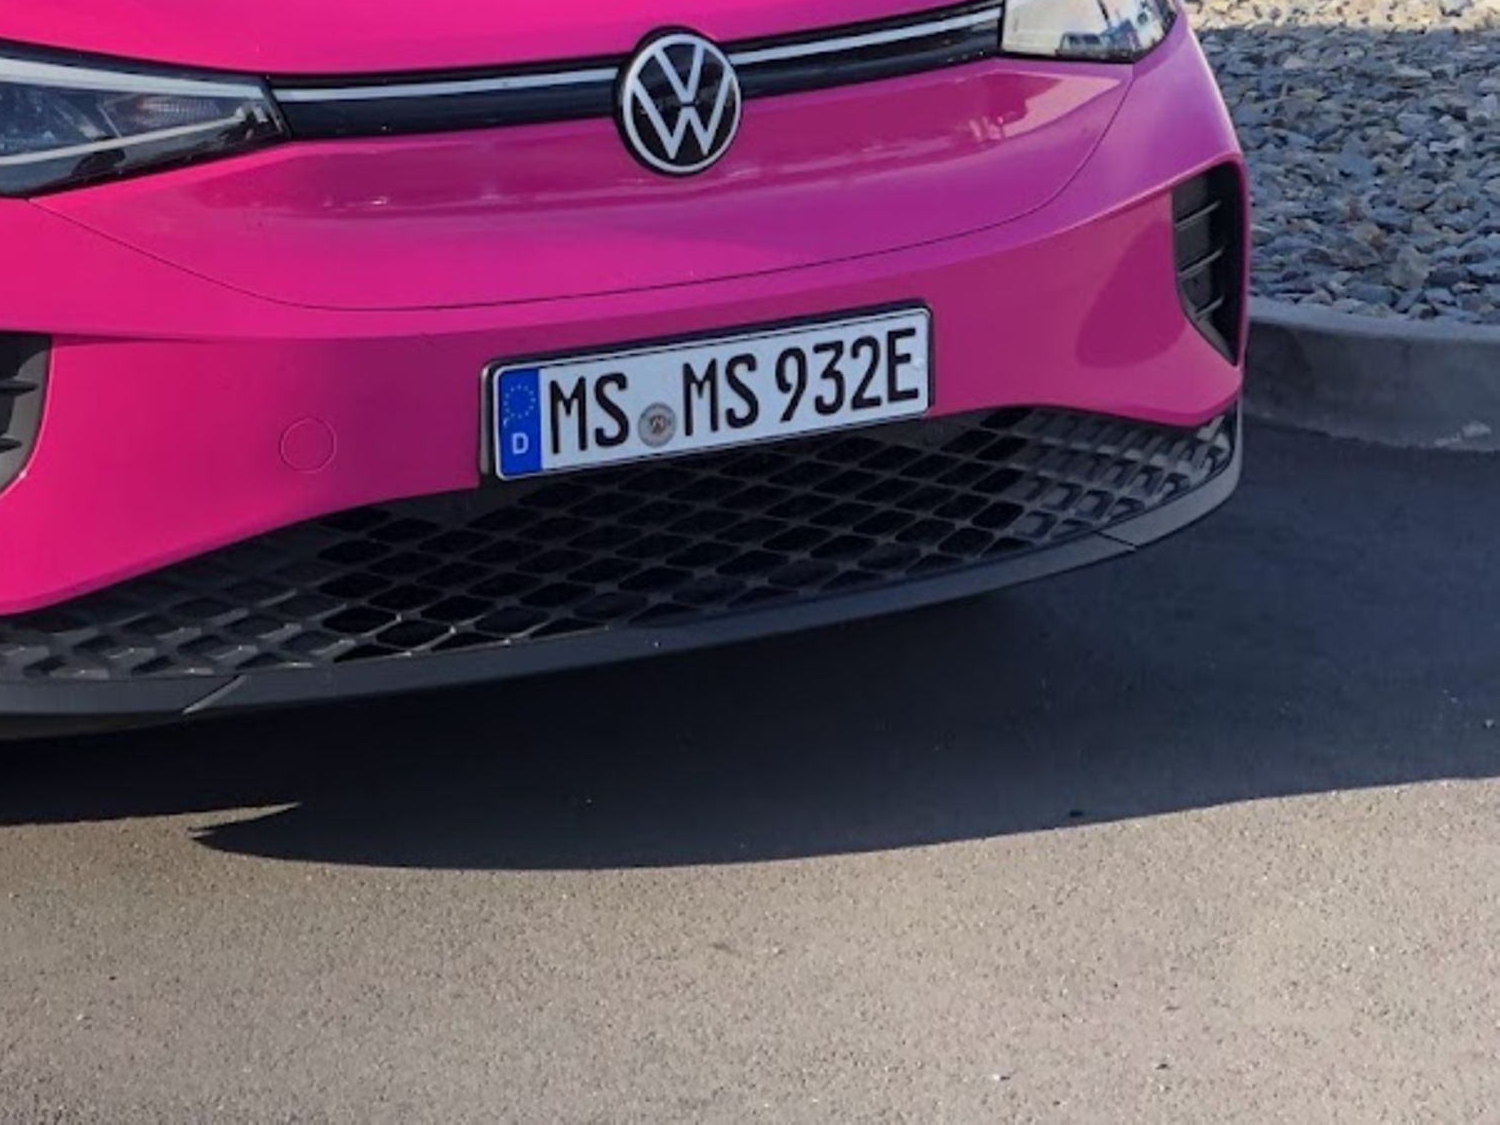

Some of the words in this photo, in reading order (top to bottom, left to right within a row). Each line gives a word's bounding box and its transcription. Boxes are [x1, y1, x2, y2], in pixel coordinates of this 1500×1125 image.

[549, 372, 630, 455] MS
[682, 352, 759, 437] MS
[774, 327, 920, 423] 932E
[511, 432, 529, 456] D
